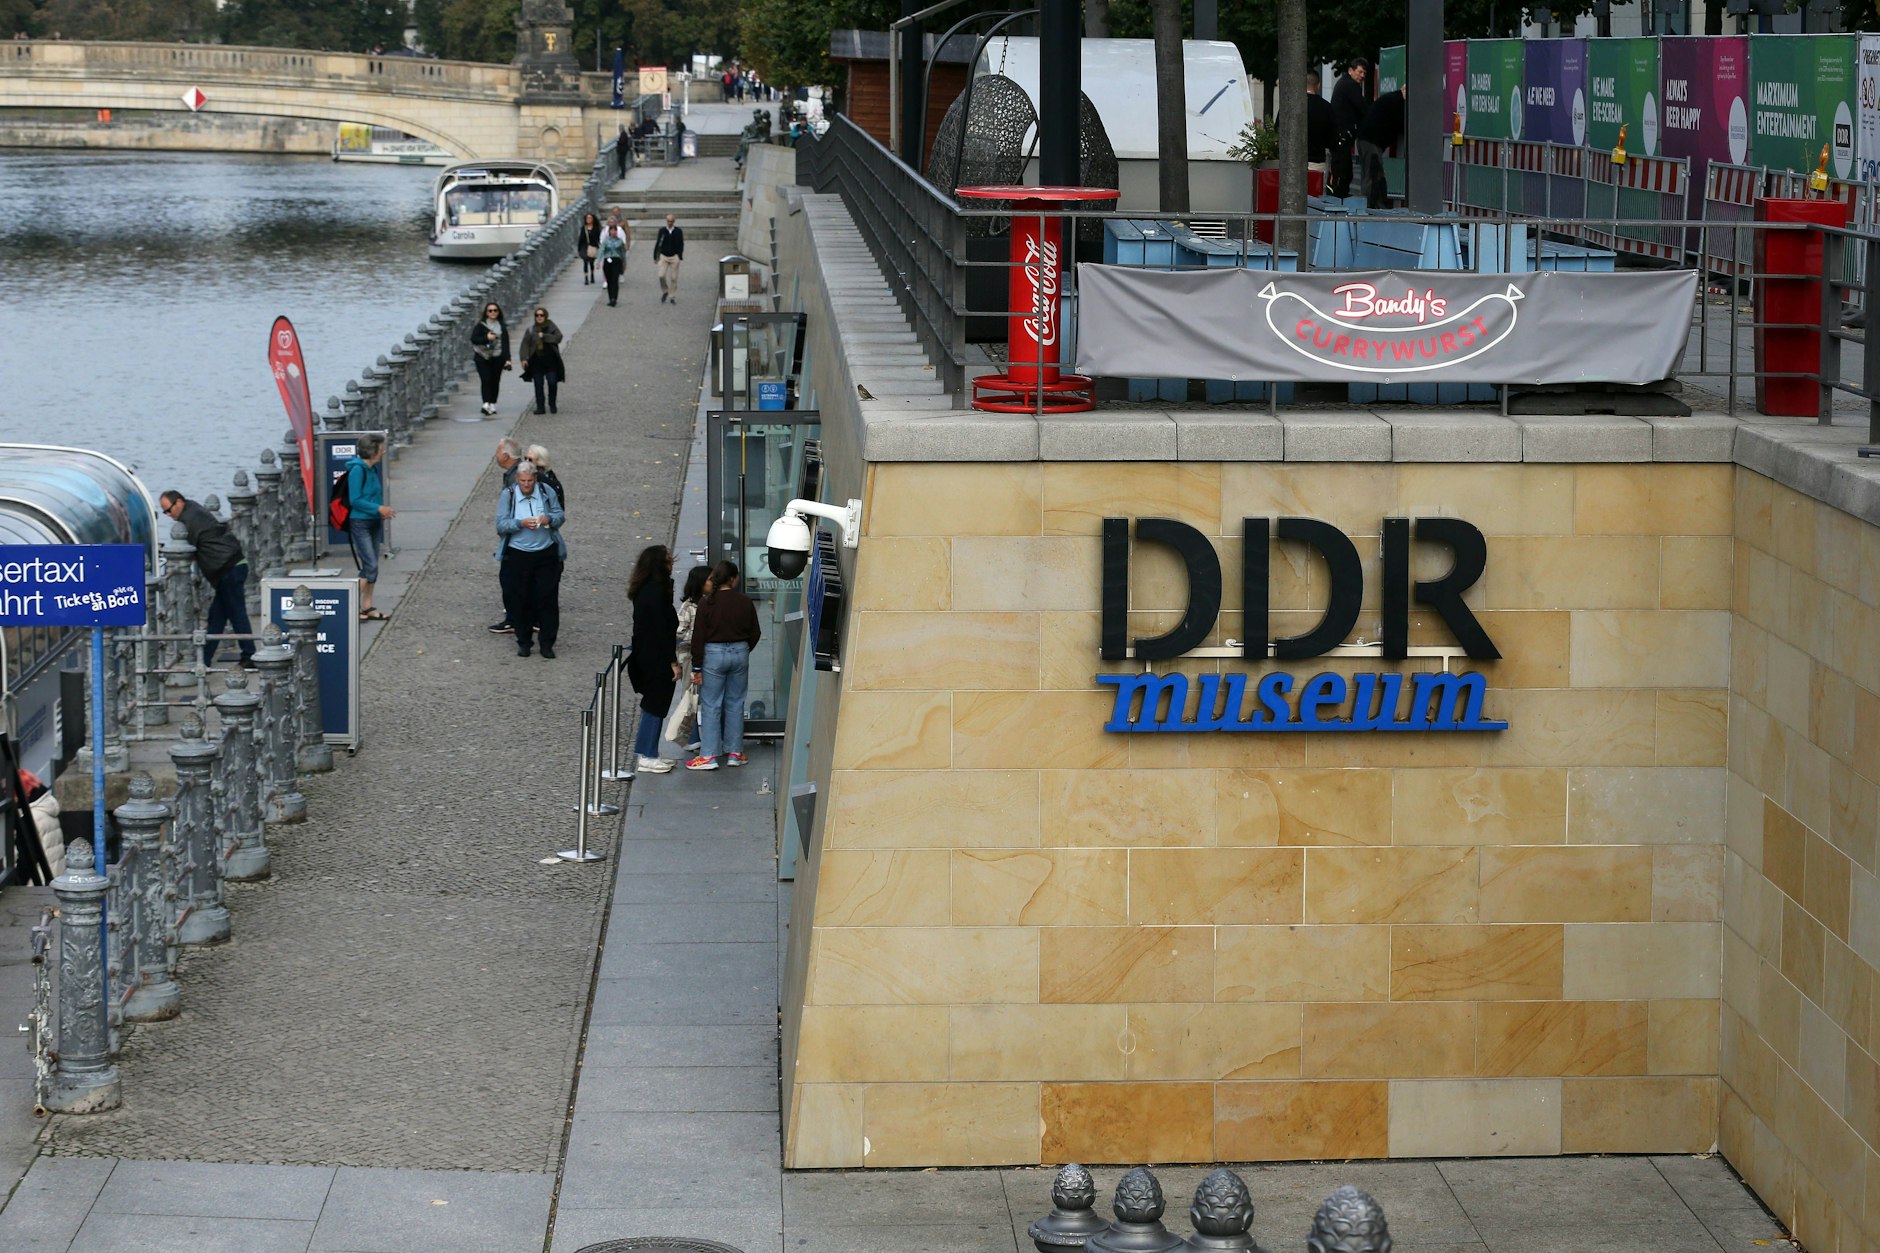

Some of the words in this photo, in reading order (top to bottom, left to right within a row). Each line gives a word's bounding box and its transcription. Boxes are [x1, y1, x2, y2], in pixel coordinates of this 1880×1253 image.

[1592, 77, 1600, 97] WE
[1601, 77, 1615, 98] MAKE
[1666, 80, 1688, 102] ALWAYS
[1757, 82, 1799, 107] MARXIMUM
[1666, 106, 1680, 129] BEER
[1681, 107, 1701, 131] HAPPY
[1757, 111, 1817, 140] ENTERTAINMENT
[1837, 128, 1849, 145] DDR
[452, 230, 476, 240] Carola
[1333, 282, 1448, 324] Bandy's
[1294, 315, 1490, 362] CURRYWURST
[0, 555, 84, 583] ertaxi
[54, 591, 103, 609] Tickets
[91, 600, 108, 612] an
[107, 590, 139, 609] Bord
[1101, 516, 1503, 661] DDR
[0, 589, 44, 616] hrt
[1095, 671, 1509, 732] museum
